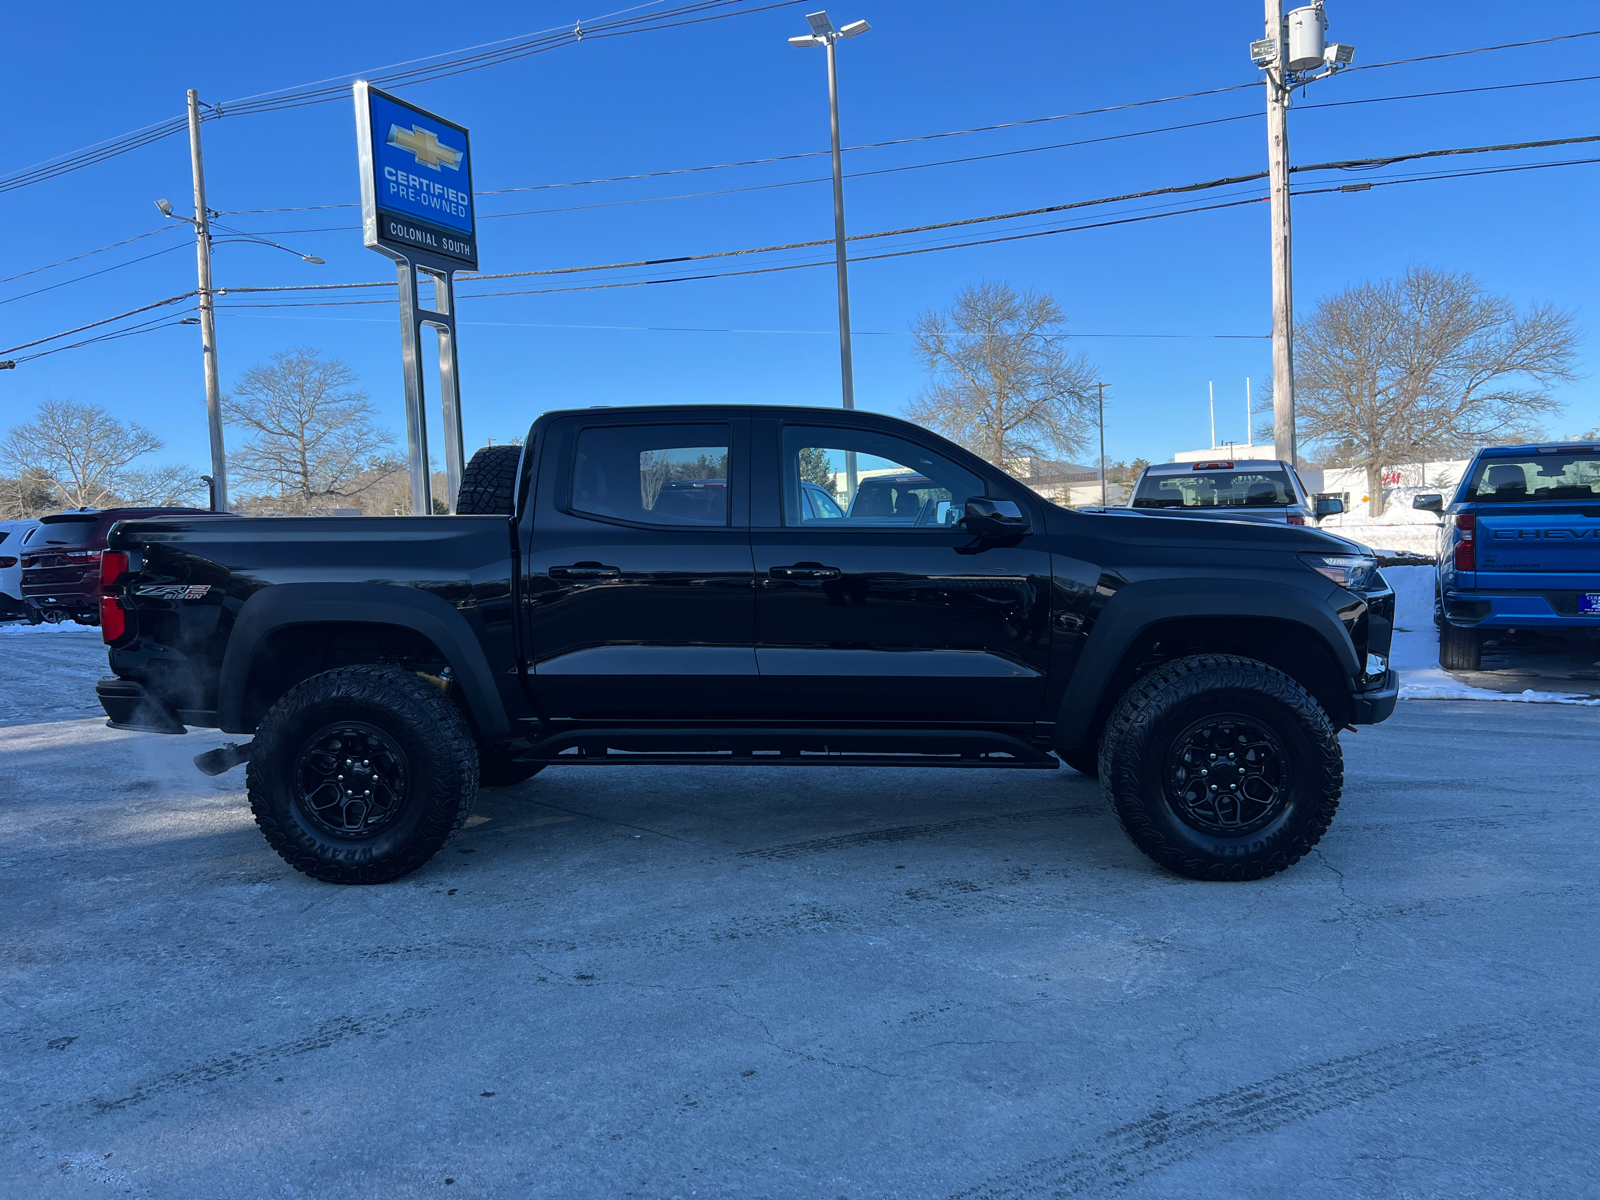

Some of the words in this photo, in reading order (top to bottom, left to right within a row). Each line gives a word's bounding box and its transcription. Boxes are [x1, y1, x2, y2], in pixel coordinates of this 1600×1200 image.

[384, 166, 469, 206] CERTIFIED
[389, 183, 466, 218] PRE-OWNED
[390, 222, 438, 247] COLONIAL
[442, 239, 471, 256] SOUTH
[136, 585, 212, 596] ZR2
